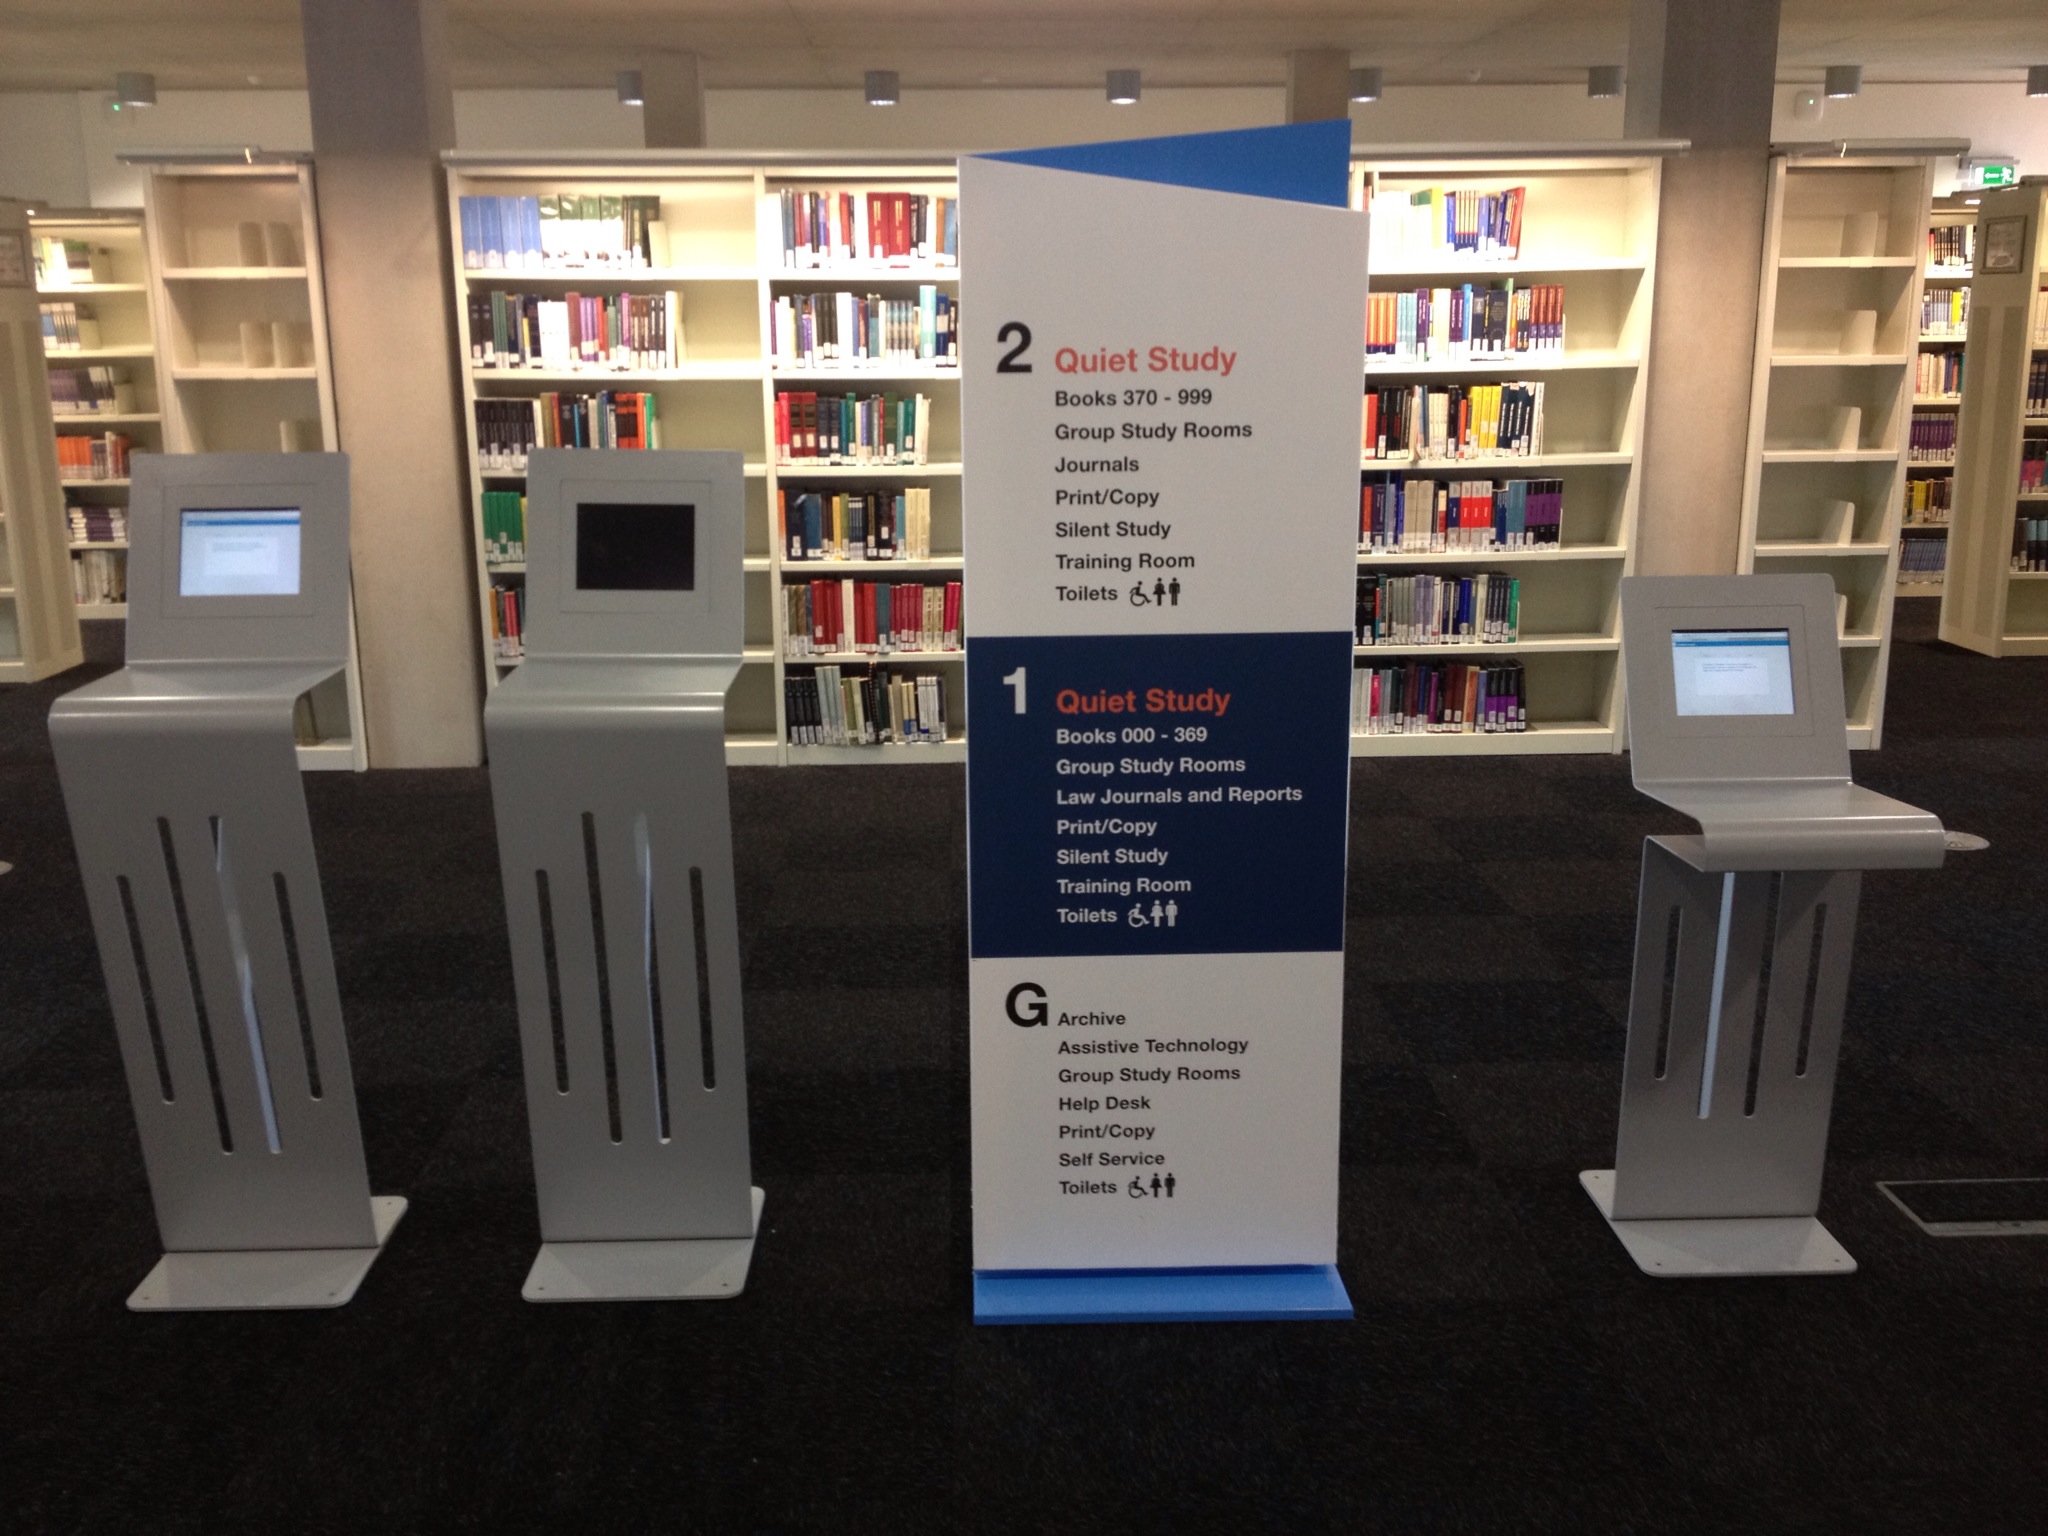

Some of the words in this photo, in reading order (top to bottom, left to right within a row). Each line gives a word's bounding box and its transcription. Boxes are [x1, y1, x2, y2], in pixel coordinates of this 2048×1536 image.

[996, 321, 1033, 374] 2
[1054, 347, 1138, 375] Quiet
[1147, 345, 1237, 377] Study
[1055, 390, 1117, 407] Books
[1123, 389, 1158, 406] 370
[1177, 388, 1213, 405] 999
[1054, 423, 1115, 443] Group
[1121, 422, 1177, 442] Study
[1183, 421, 1253, 438] Rooms
[1054, 456, 1140, 473] Journals
[1055, 488, 1160, 508] Print/Copy
[1055, 521, 1110, 538] Silent
[1116, 520, 1171, 540] Study
[1055, 553, 1132, 573] Training
[1139, 552, 1195, 569] Room
[1055, 585, 1118, 602] Toilets
[1002, 666, 1027, 715] 1
[1056, 689, 1137, 715] Quiet
[1145, 687, 1231, 717] Study
[1056, 728, 1117, 745] Books
[1121, 727, 1156, 744] 000
[1174, 726, 1208, 743] 369
[1055, 758, 1115, 778] Group
[1119, 757, 1175, 777] Study
[1179, 757, 1246, 773] Rooms
[1056, 789, 1096, 805] Law
[1100, 787, 1183, 805] Journals
[1187, 786, 1223, 803] and
[1228, 786, 1303, 805] Reports
[1056, 818, 1158, 837] Print/Copy
[1056, 848, 1110, 865] Silent
[1114, 847, 1169, 866] Study
[1056, 878, 1131, 897] Training
[1136, 877, 1192, 893] Room
[1056, 908, 1118, 924] Toilets
[1005, 981, 1049, 1028] G
[1057, 1011, 1126, 1027] Archive
[1057, 1039, 1139, 1055] Assistive
[1144, 1037, 1249, 1055] Technology
[1058, 1068, 1114, 1085] Group
[1119, 1067, 1172, 1084] Study
[1177, 1066, 1241, 1081] Rooms
[1059, 1096, 1100, 1114] Help
[1105, 1095, 1151, 1110] Desk
[1059, 1123, 1155, 1141] Print/Copy
[1059, 1152, 1094, 1167] Self
[1098, 1152, 1165, 1167] Service
[1058, 1180, 1118, 1195] Toilets
